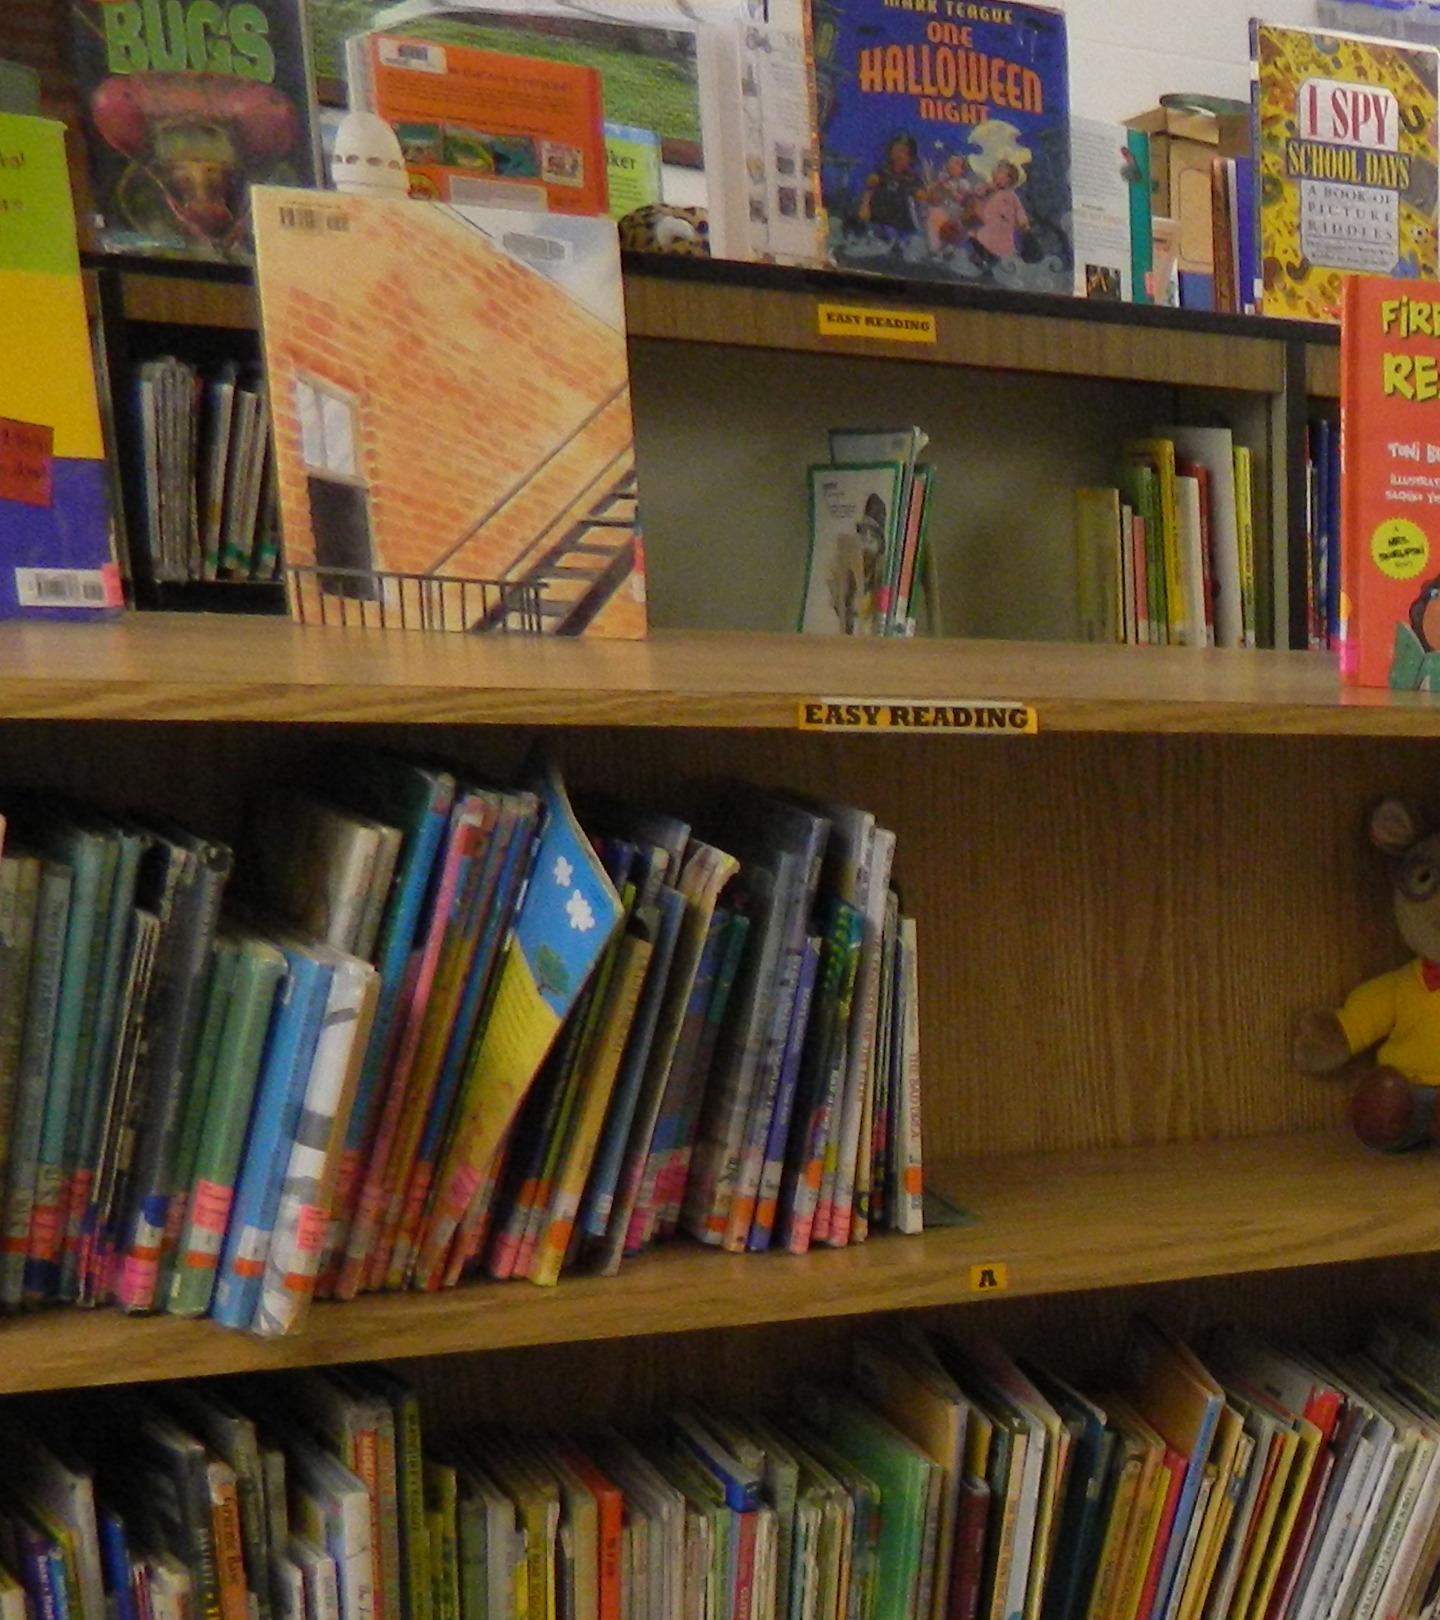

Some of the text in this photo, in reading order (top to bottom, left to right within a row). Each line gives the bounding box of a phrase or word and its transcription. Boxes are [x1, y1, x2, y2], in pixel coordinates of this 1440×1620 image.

[947, 0, 1013, 25] TEAGUE
[104, 0, 275, 84] BUGS
[926, 20, 973, 49] ONE
[859, 45, 1043, 115] HALLOWEEN
[919, 98, 991, 126] NIGHT
[1307, 84, 1390, 146] I SPY
[1286, 142, 1411, 190] SCHOOL DAYS
[1323, 187, 1366, 202] BOOK
[1308, 201, 1391, 222] PICTURE
[1308, 219, 1393, 239] RIDDLES
[826, 311, 931, 333] EASY READING
[1387, 441, 1421, 462] TONI
[804, 704, 1029, 729] EASY READING
[978, 1270, 997, 1288] A
[1361, 1486, 1416, 1617] TOWN MOUSE COUNTRY
